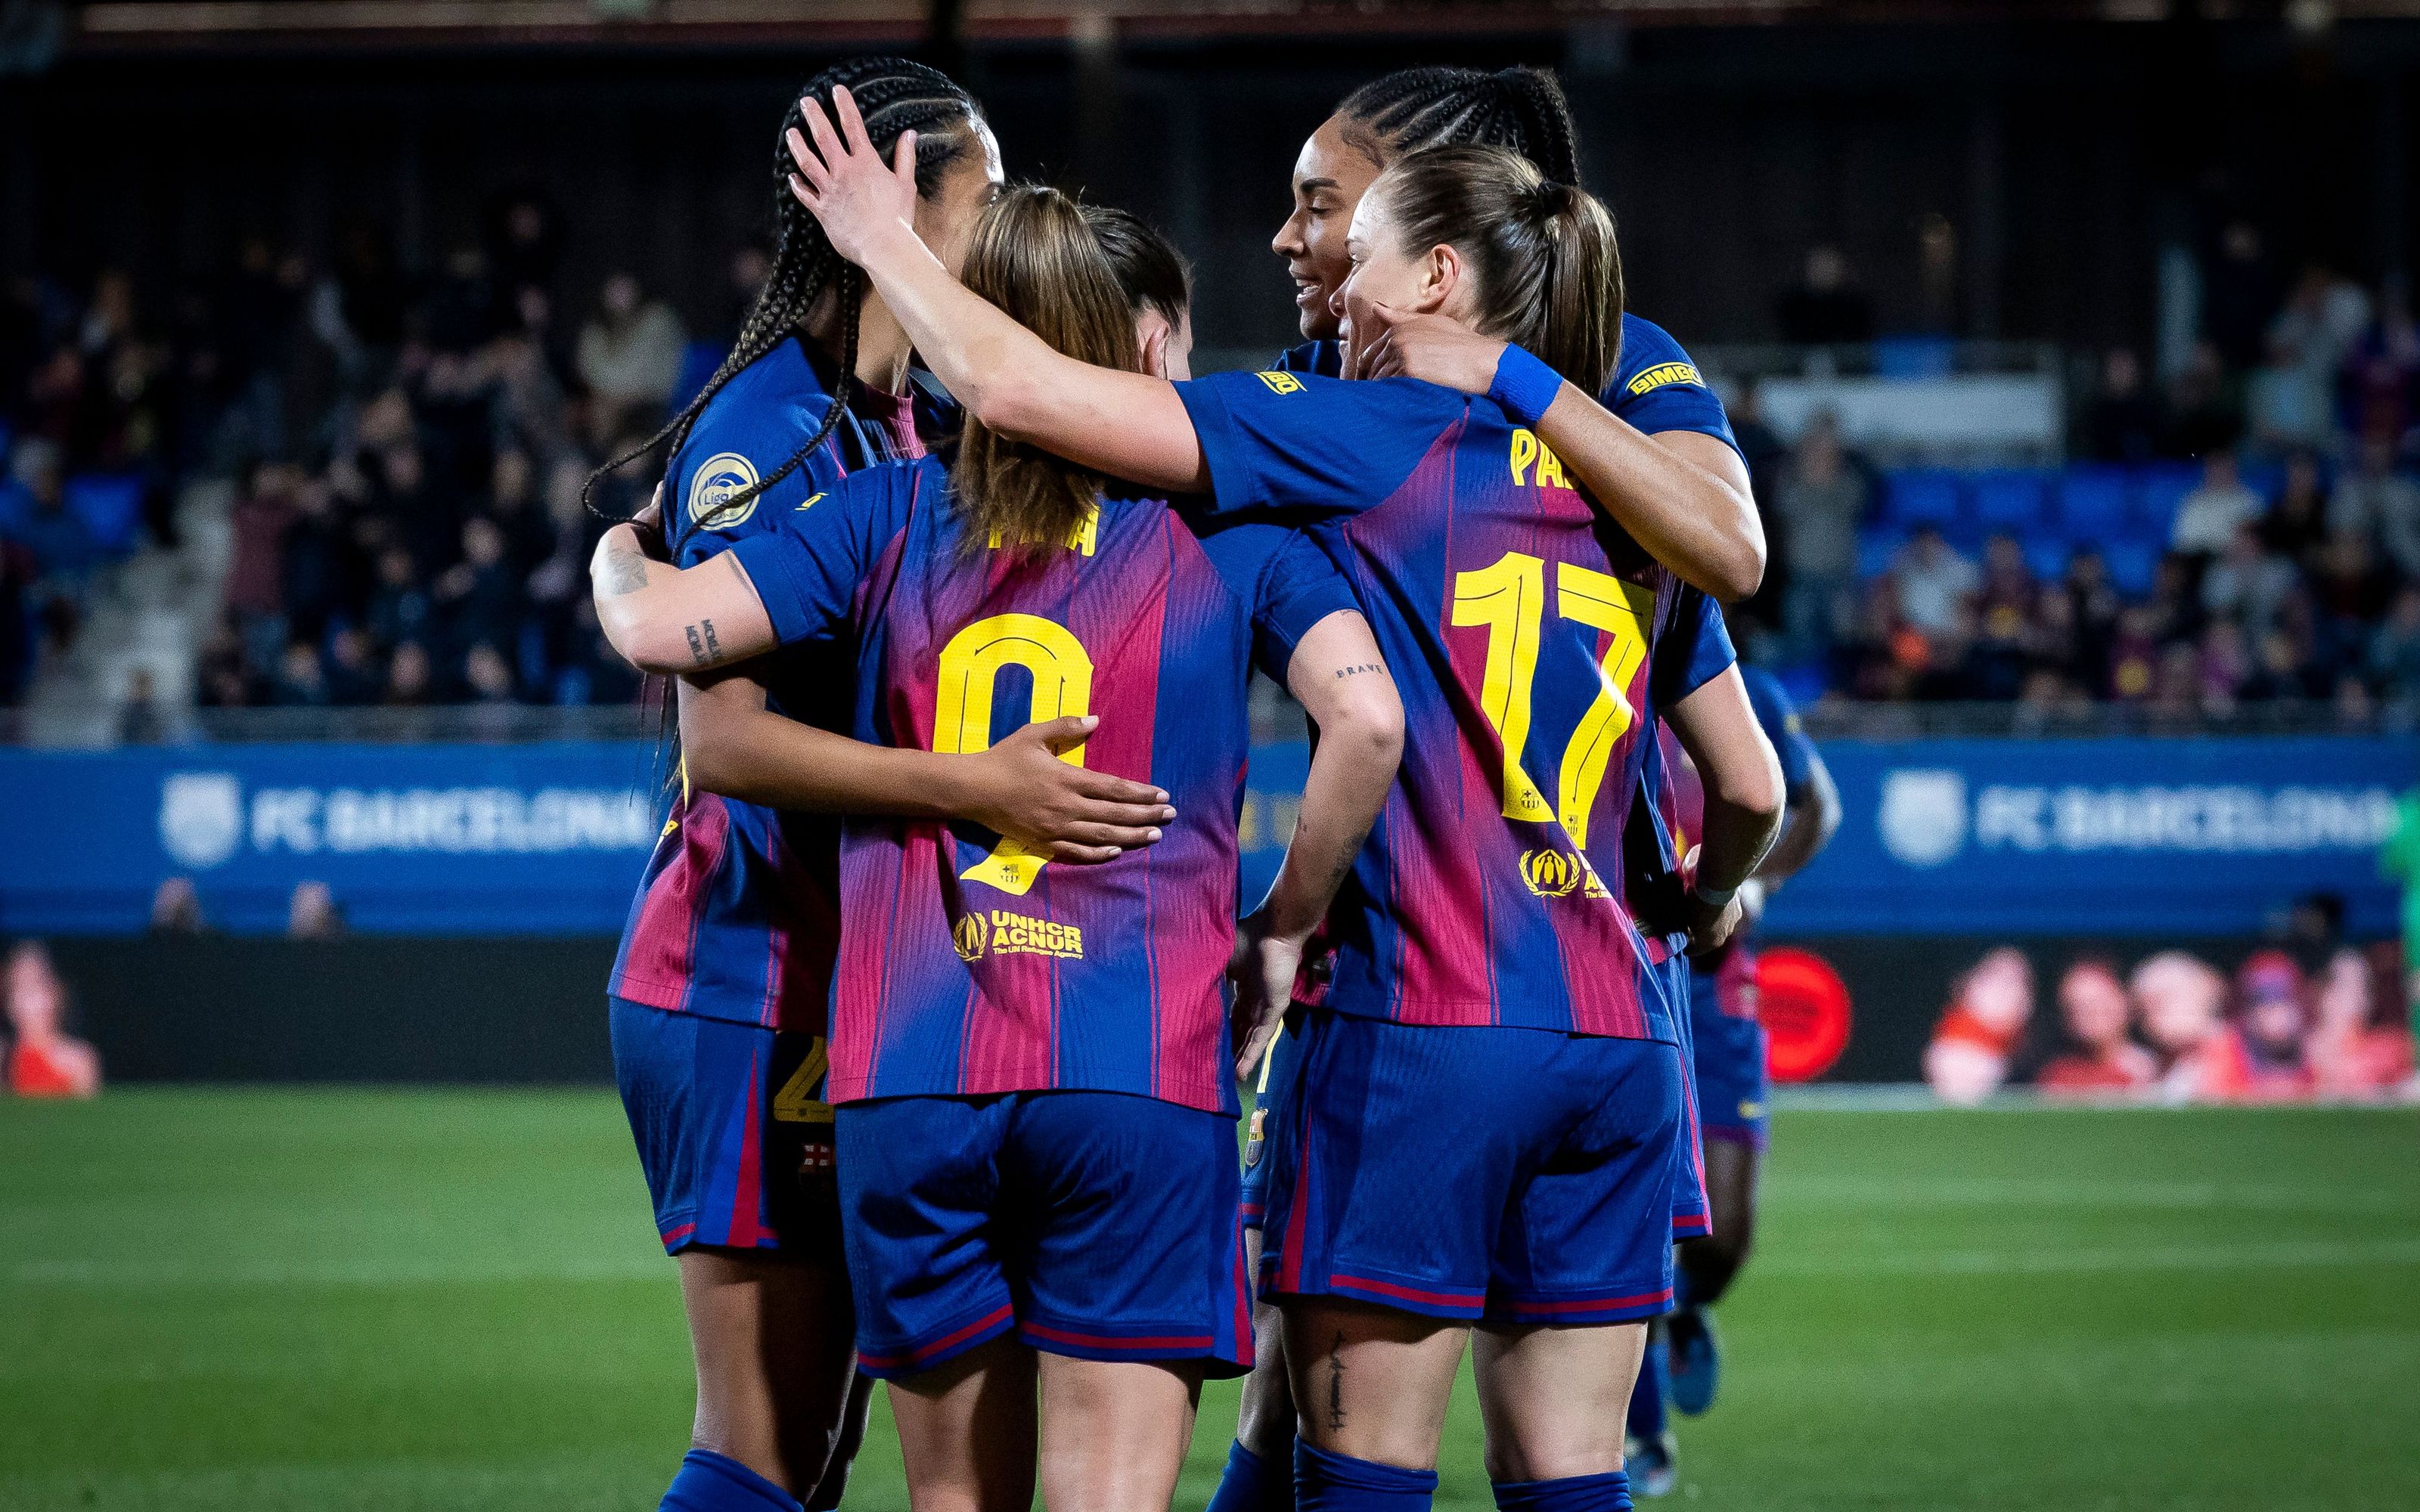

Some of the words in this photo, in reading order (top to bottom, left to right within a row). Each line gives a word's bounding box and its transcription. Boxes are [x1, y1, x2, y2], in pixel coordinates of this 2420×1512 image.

[1510, 429, 1573, 490] PA
[1451, 550, 1654, 851] 17
[932, 612, 1094, 896] 9
[991, 909, 1081, 942] UNHCR
[991, 927, 1083, 953] ACNUR
[1008, 945, 1021, 953] UN
